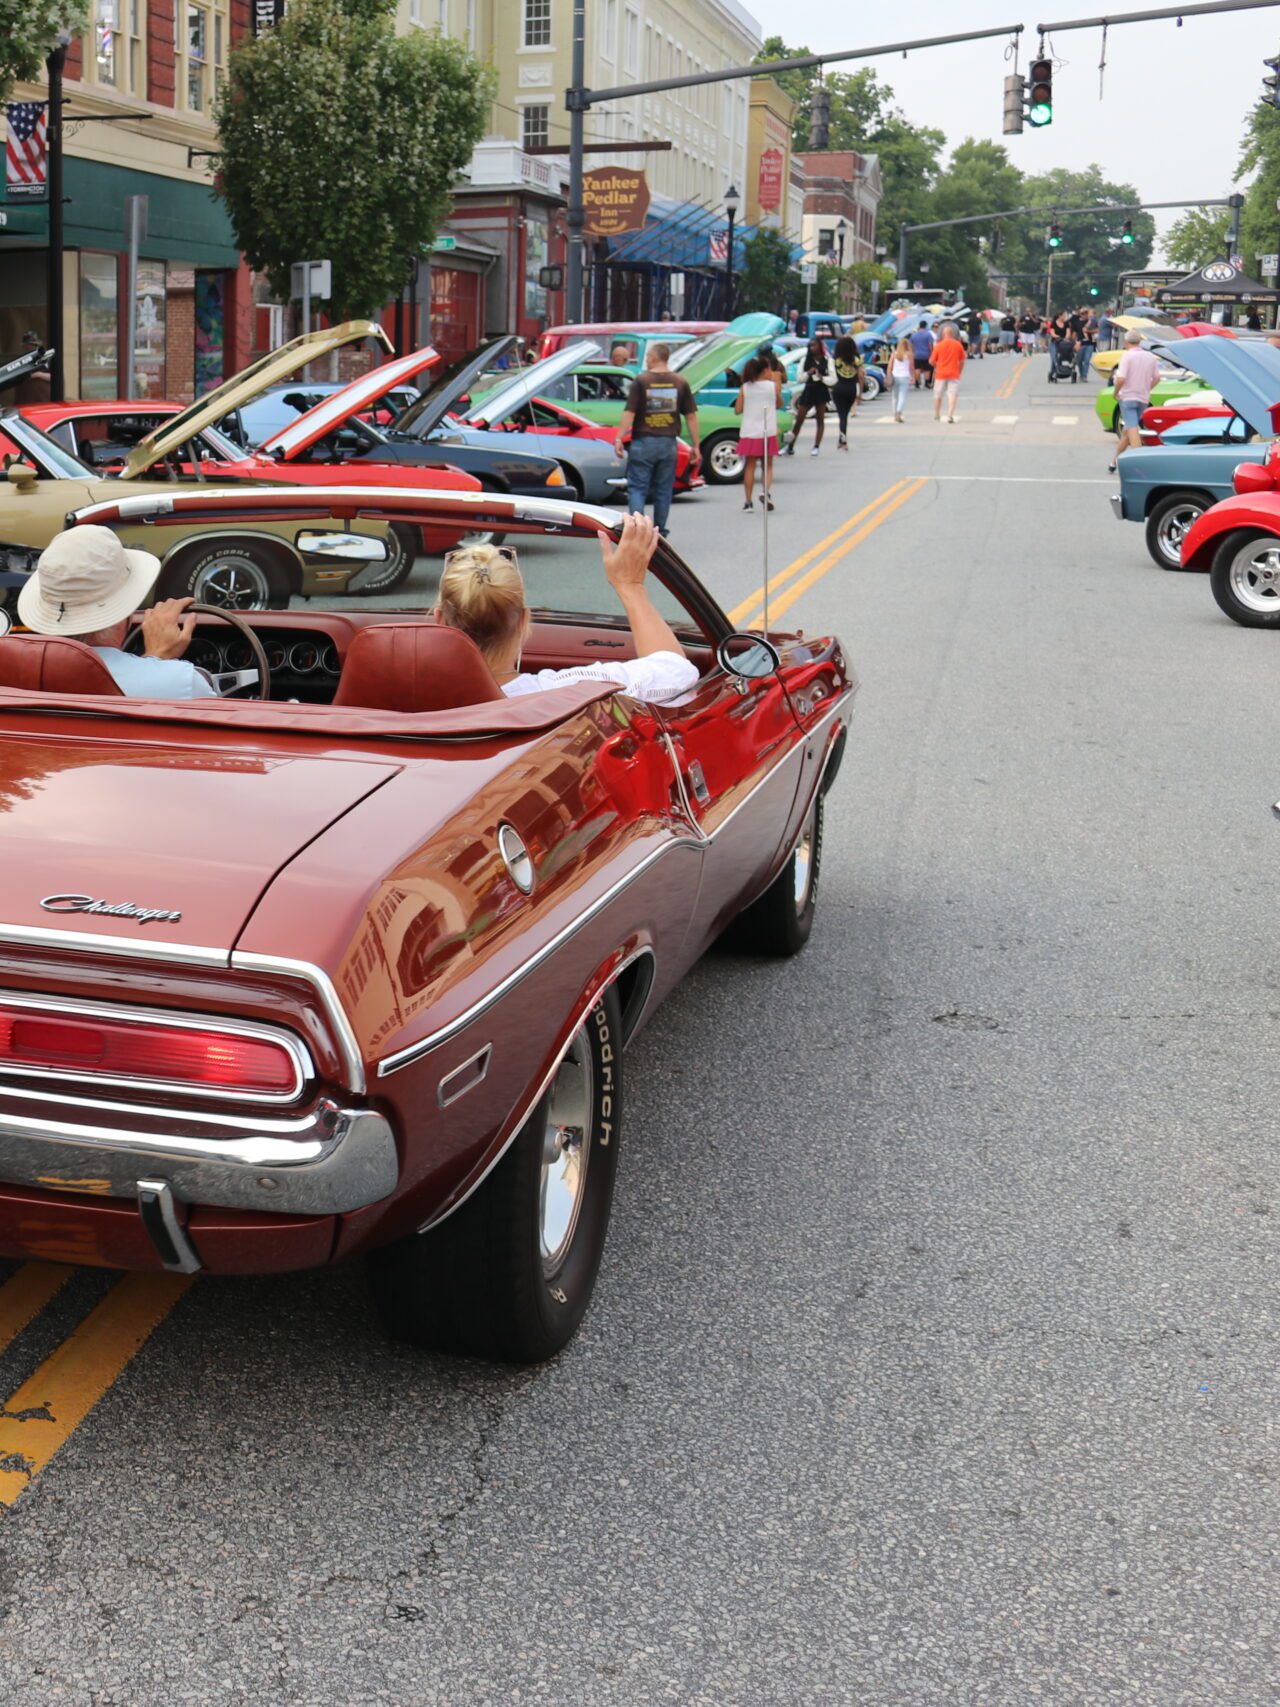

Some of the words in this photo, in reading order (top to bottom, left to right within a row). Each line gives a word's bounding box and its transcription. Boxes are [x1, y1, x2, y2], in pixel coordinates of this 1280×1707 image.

[582, 176, 639, 190] Yankee
[582, 191, 637, 206] Pedlar
[601, 208, 618, 217] Inn
[40, 893, 182, 925] Challenger
